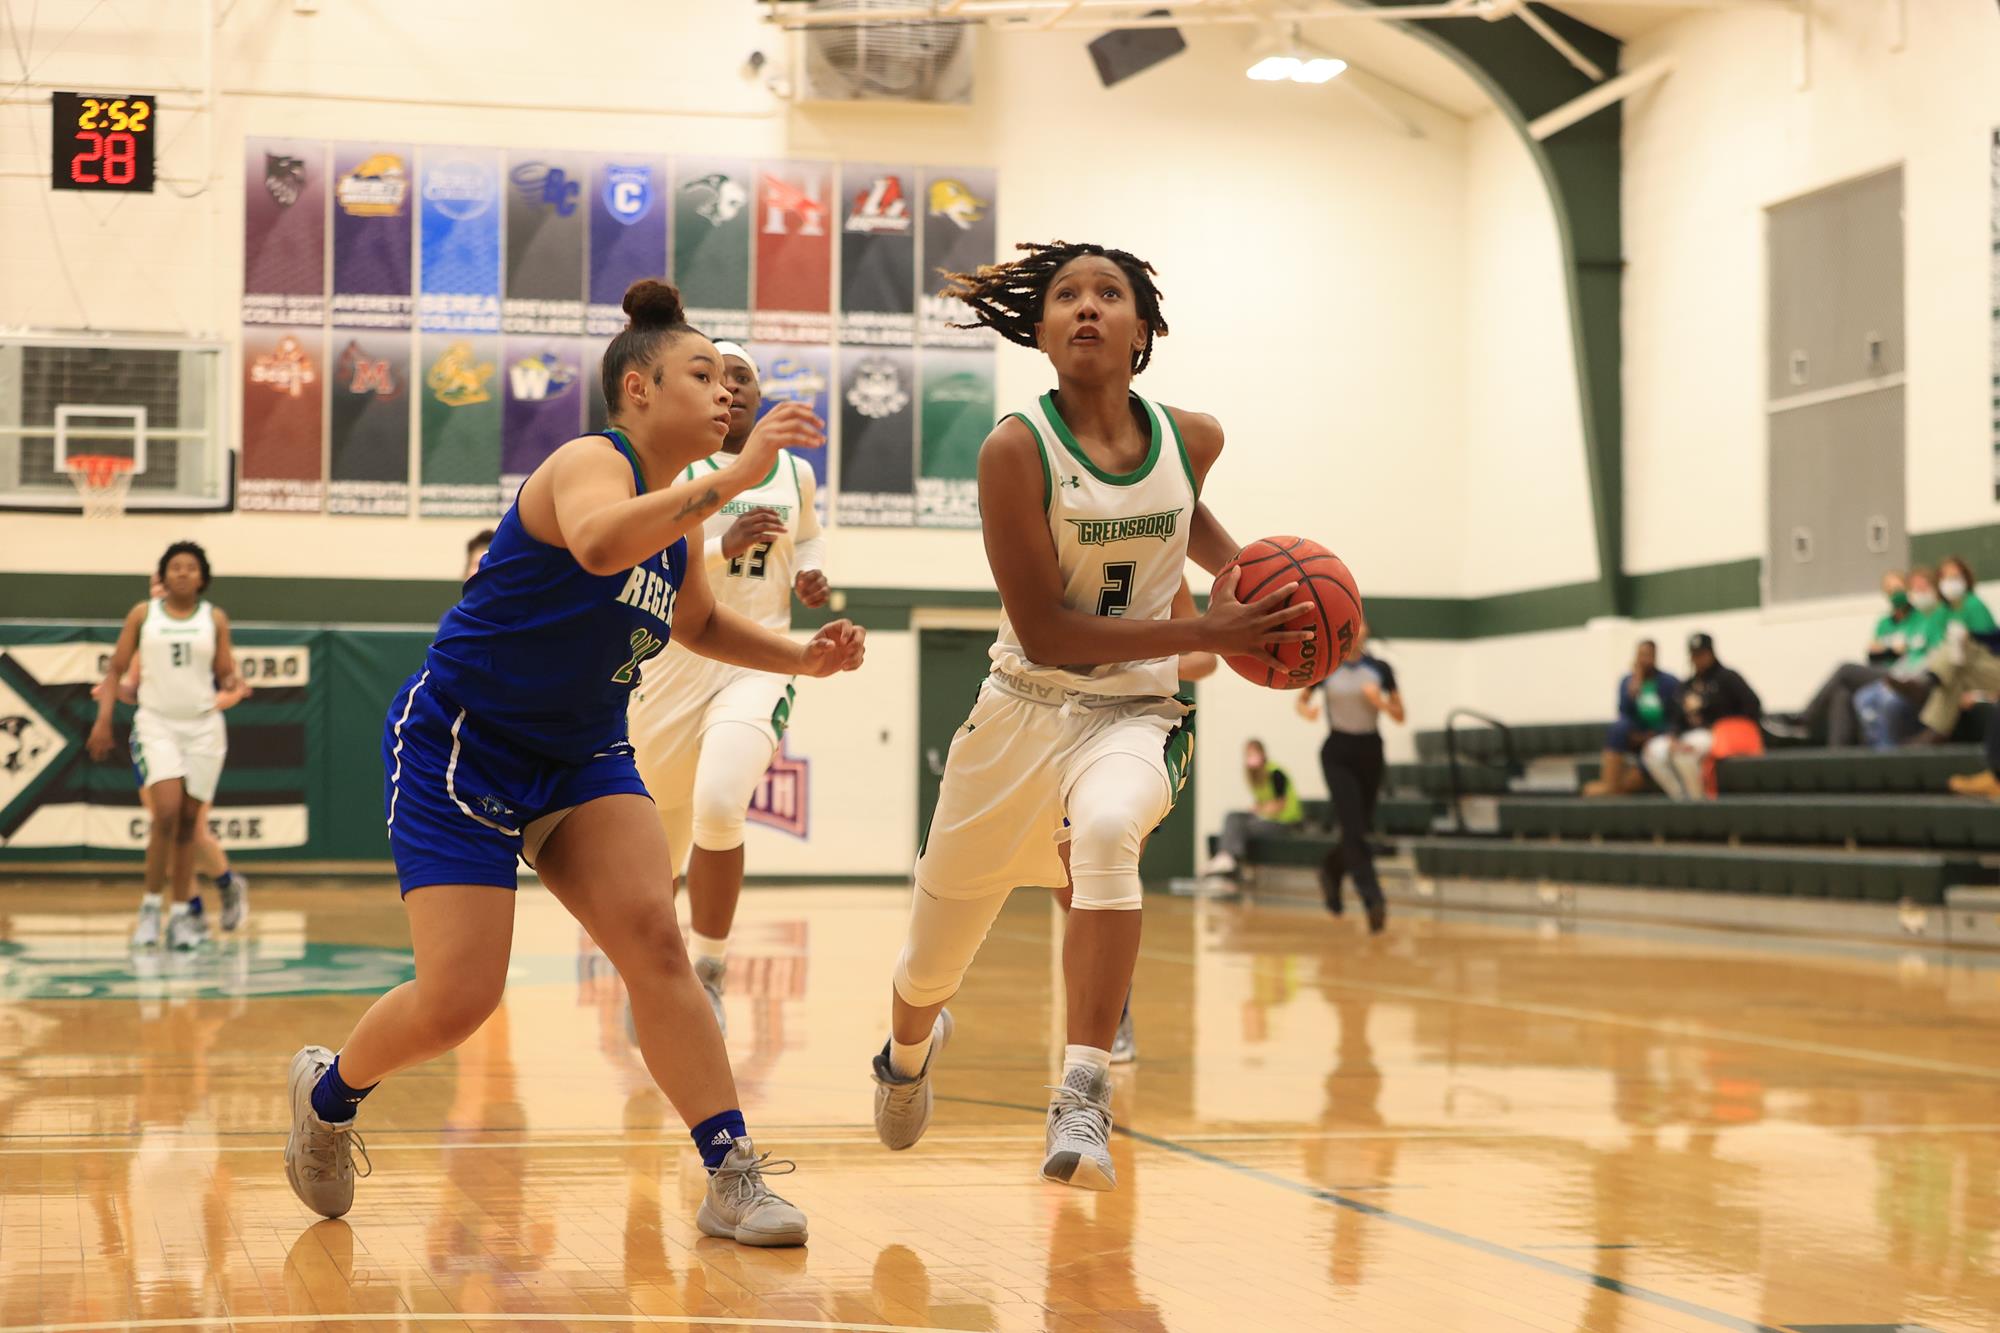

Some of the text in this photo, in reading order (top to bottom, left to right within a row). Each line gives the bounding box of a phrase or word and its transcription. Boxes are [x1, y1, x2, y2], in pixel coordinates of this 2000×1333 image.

[79, 99, 149, 132] 2:52
[71, 132, 135, 184] 28
[613, 183, 643, 214] C
[1072, 509, 1180, 546] GREENSBORO
[1096, 561, 1136, 616] 2
[711, 1137, 734, 1146] adida
